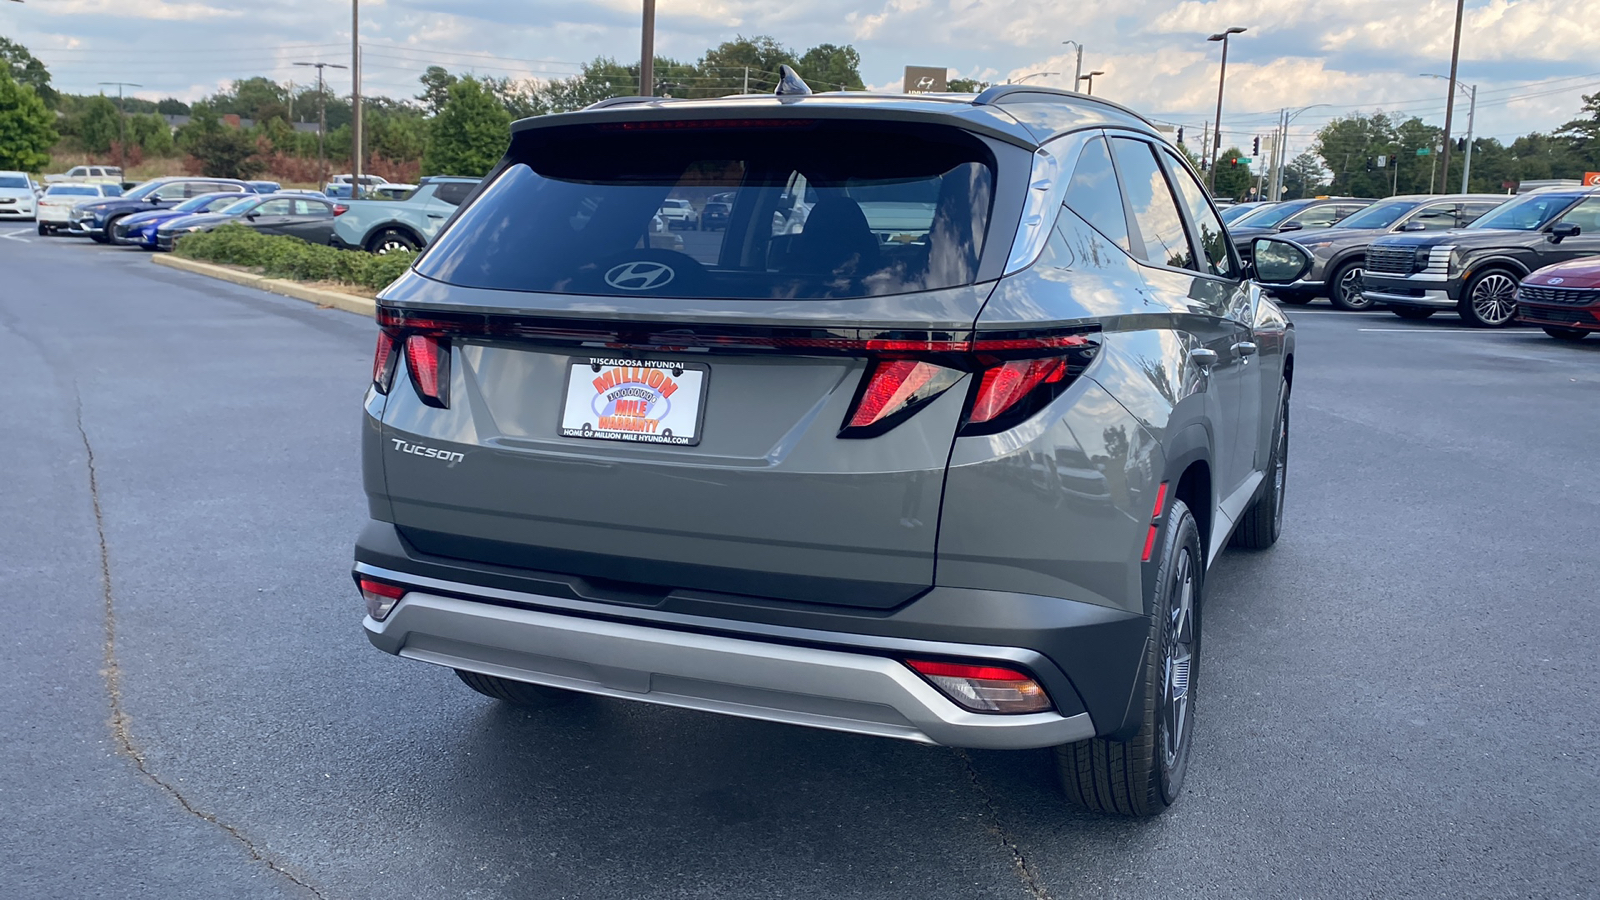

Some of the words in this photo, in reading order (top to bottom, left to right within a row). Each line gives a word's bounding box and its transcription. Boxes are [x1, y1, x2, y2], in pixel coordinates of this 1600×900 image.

[589, 357, 642, 367] TUSCALOOSA
[644, 360, 684, 369] HYUNDAI
[592, 366, 679, 399] MILLION
[614, 399, 648, 418] MILE
[598, 415, 660, 433] WARRANTY
[563, 429, 583, 437] HOME
[584, 430, 594, 438] OF
[594, 431, 622, 440] MILLION
[622, 433, 638, 441] MILE
[638, 435, 689, 445] HYUNDAI.COM
